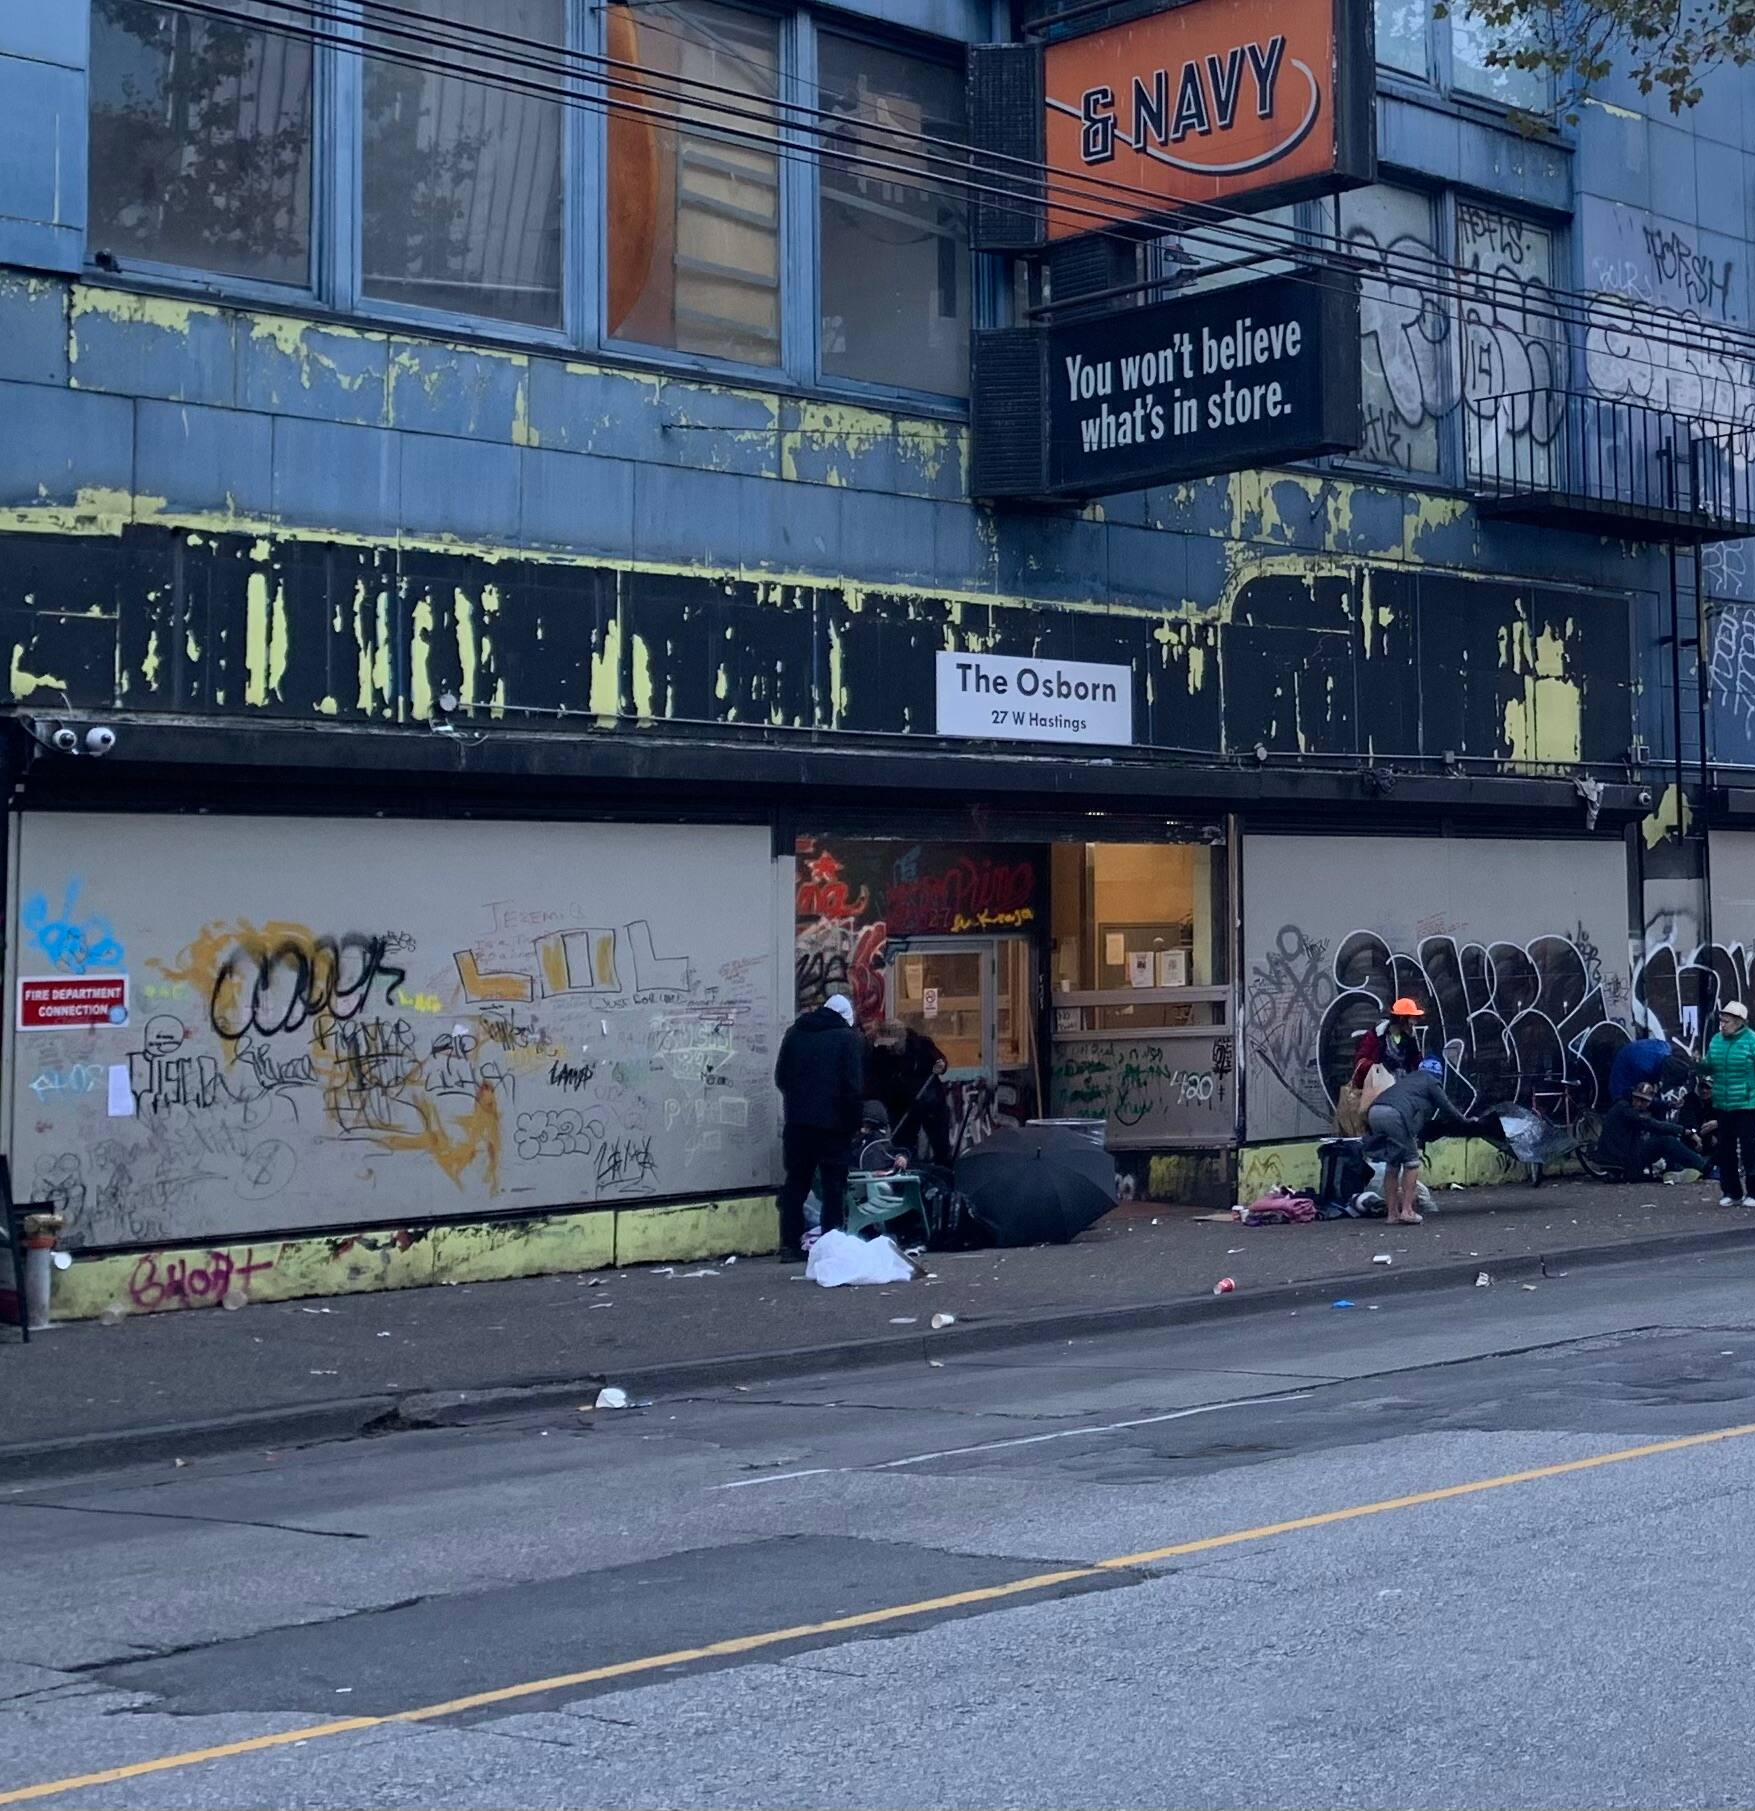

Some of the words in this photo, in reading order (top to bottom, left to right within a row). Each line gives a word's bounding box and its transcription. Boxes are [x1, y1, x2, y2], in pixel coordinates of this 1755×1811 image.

[1081, 85, 1116, 164] &
[1132, 35, 1286, 152] NAVY
[1066, 355, 1111, 401] You
[1120, 332, 1194, 390] won't
[1202, 318, 1301, 374] believe
[1081, 393, 1165, 452] what's
[1174, 390, 1198, 436] in
[1208, 381, 1292, 430] store.
[956, 662, 1008, 694] The
[1016, 667, 1117, 703] Osborn
[991, 710, 1008, 725] 27
[1012, 711, 1025, 726] W
[1029, 712, 1087, 733] Hastings
[25, 989, 50, 1001] FIRE
[52, 987, 122, 1000] DEPARTMENT
[38, 1004, 108, 1018] CONNECTION
[1169, 1069, 1214, 1105] 420
